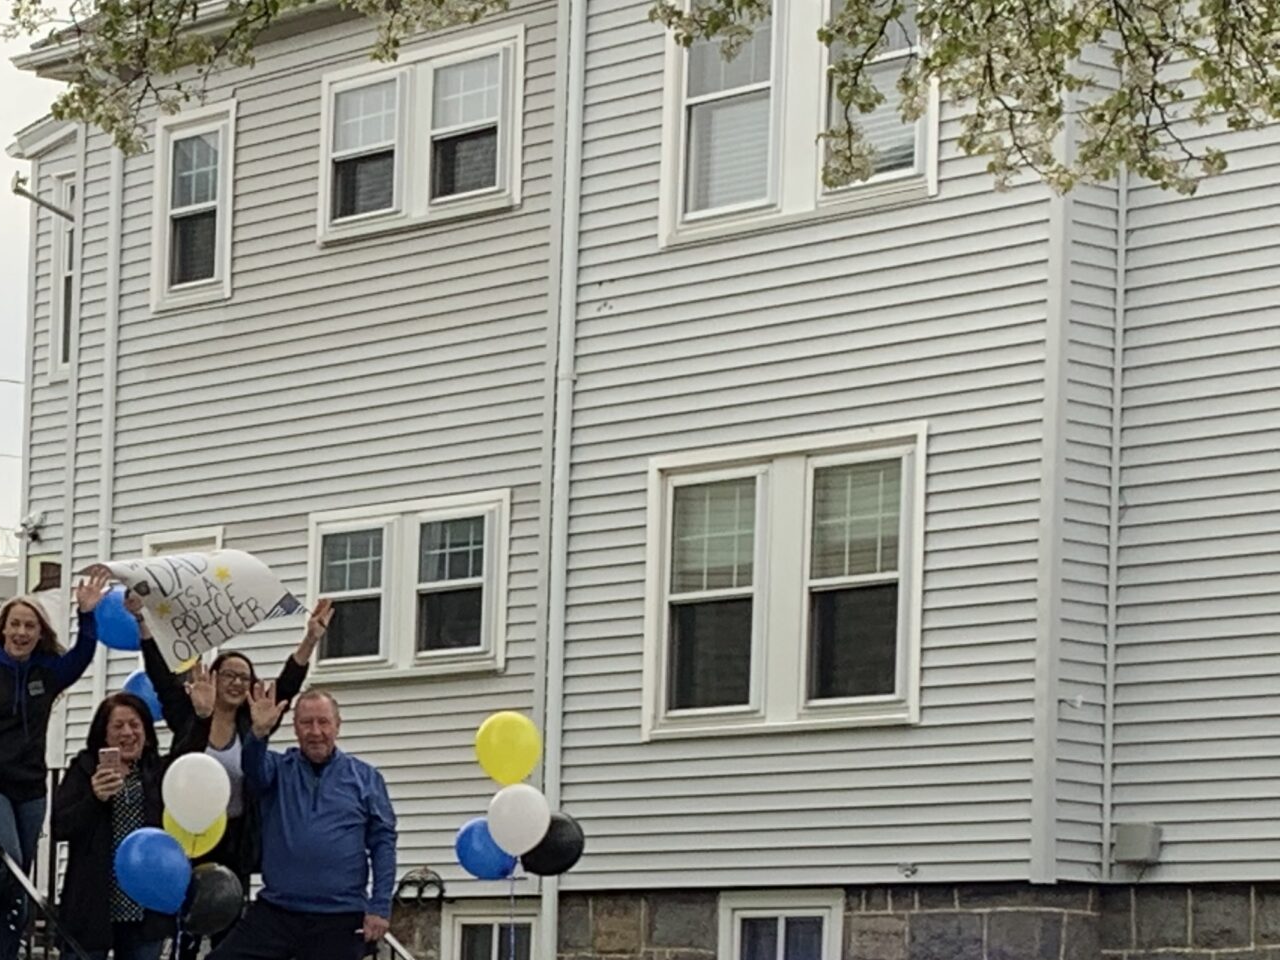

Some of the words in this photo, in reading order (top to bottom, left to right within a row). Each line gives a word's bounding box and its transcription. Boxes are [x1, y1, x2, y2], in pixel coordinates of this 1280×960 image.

[145, 553, 209, 598] DAD
[173, 585, 201, 615] IS
[202, 576, 220, 596] A
[171, 582, 242, 638] POLICE
[172, 596, 267, 663] OFFICER
